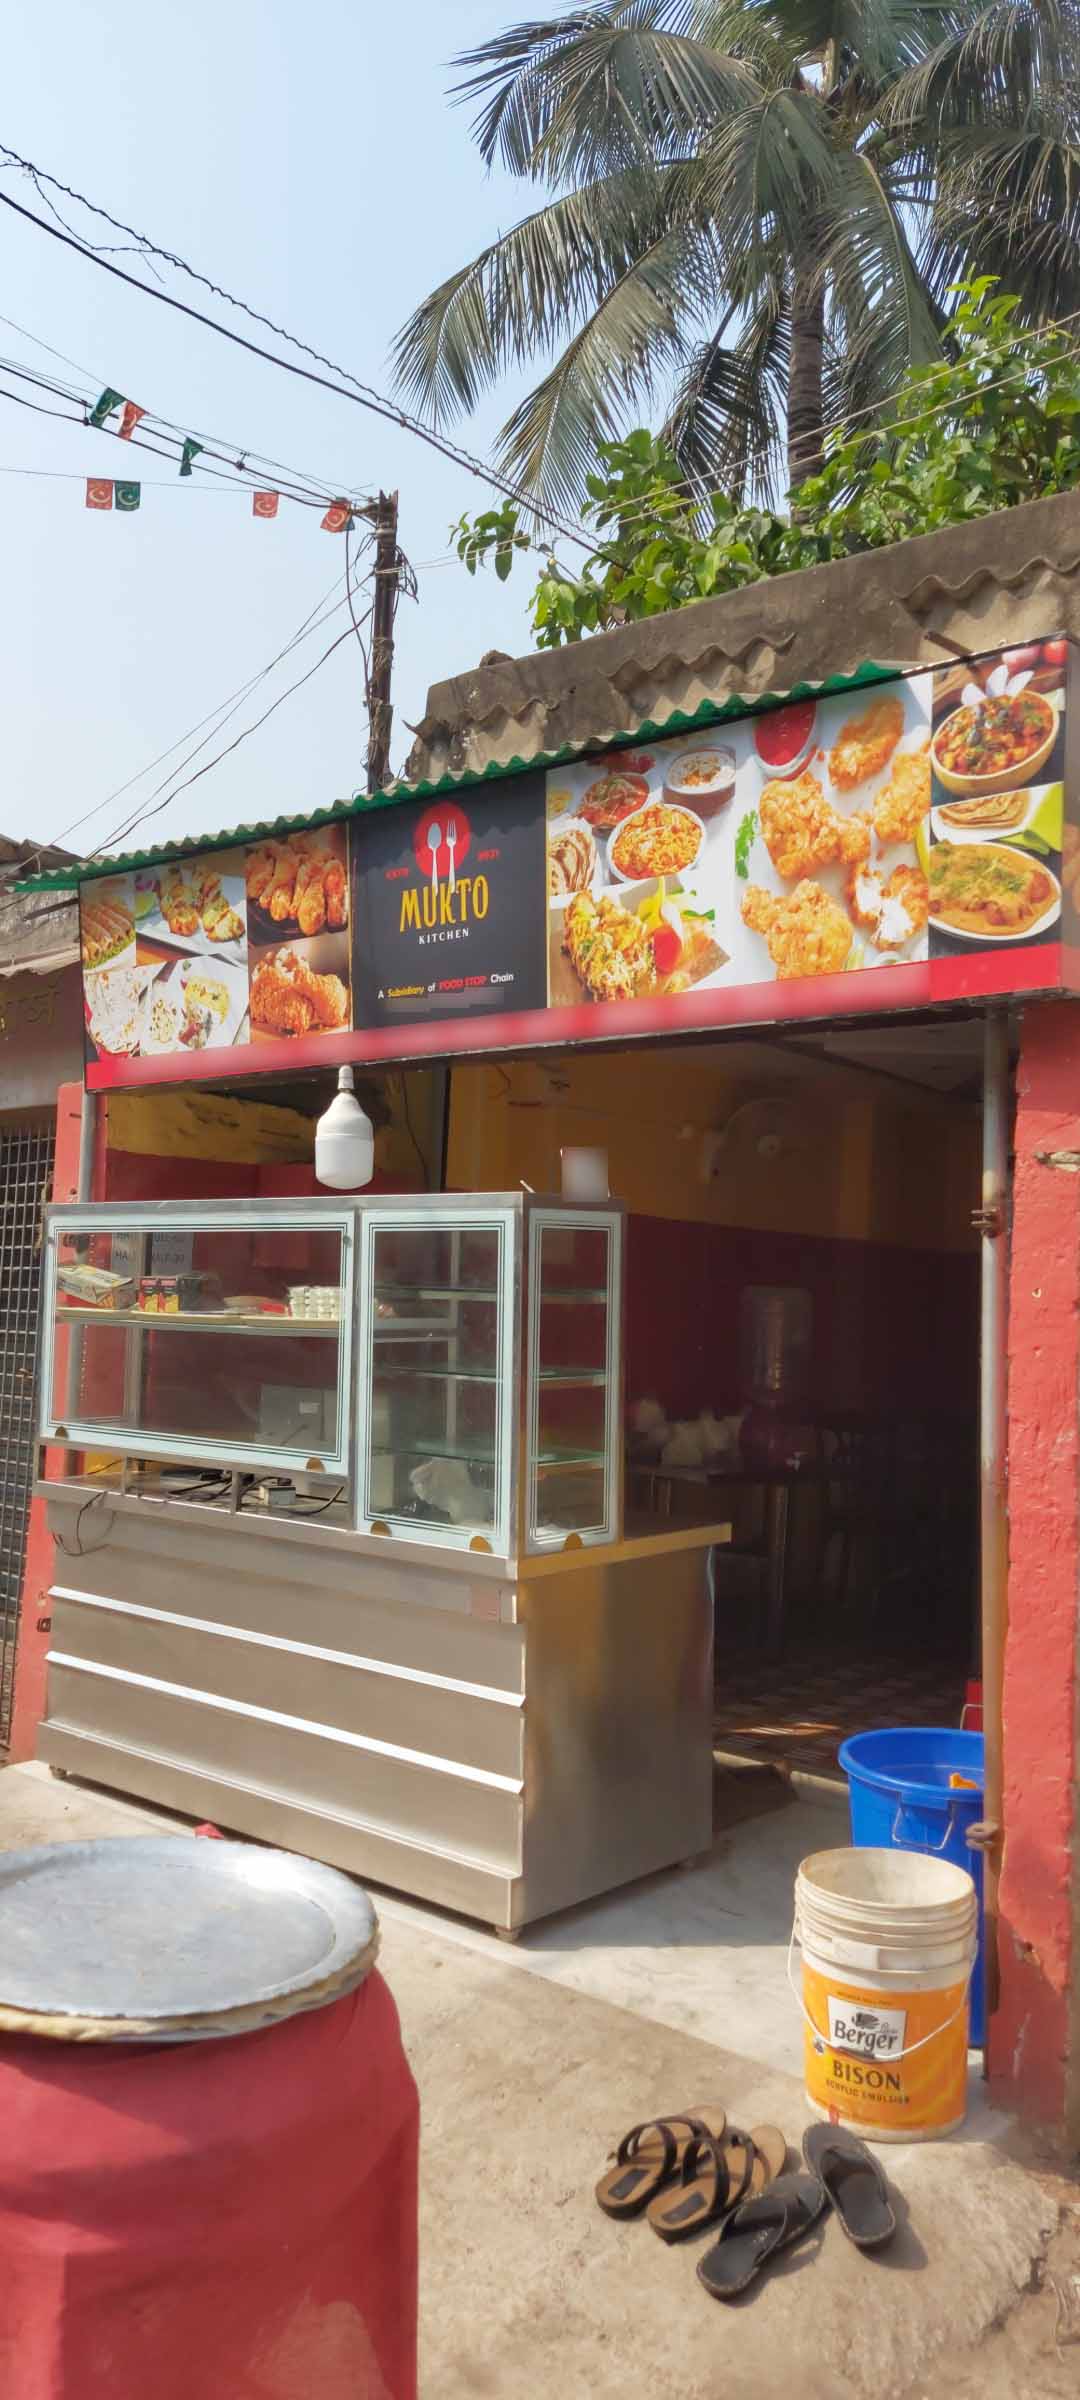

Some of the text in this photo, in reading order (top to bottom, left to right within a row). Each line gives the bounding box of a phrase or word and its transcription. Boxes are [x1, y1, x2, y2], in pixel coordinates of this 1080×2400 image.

[400, 875, 489, 932] MUKTO
[418, 928, 469, 945] KITCHEN
[378, 990, 385, 999] A
[427, 982, 436, 992] of
[490, 973, 514, 984] Chain
[834, 2019, 898, 2052] Berger
[833, 2060, 900, 2091] BISON
